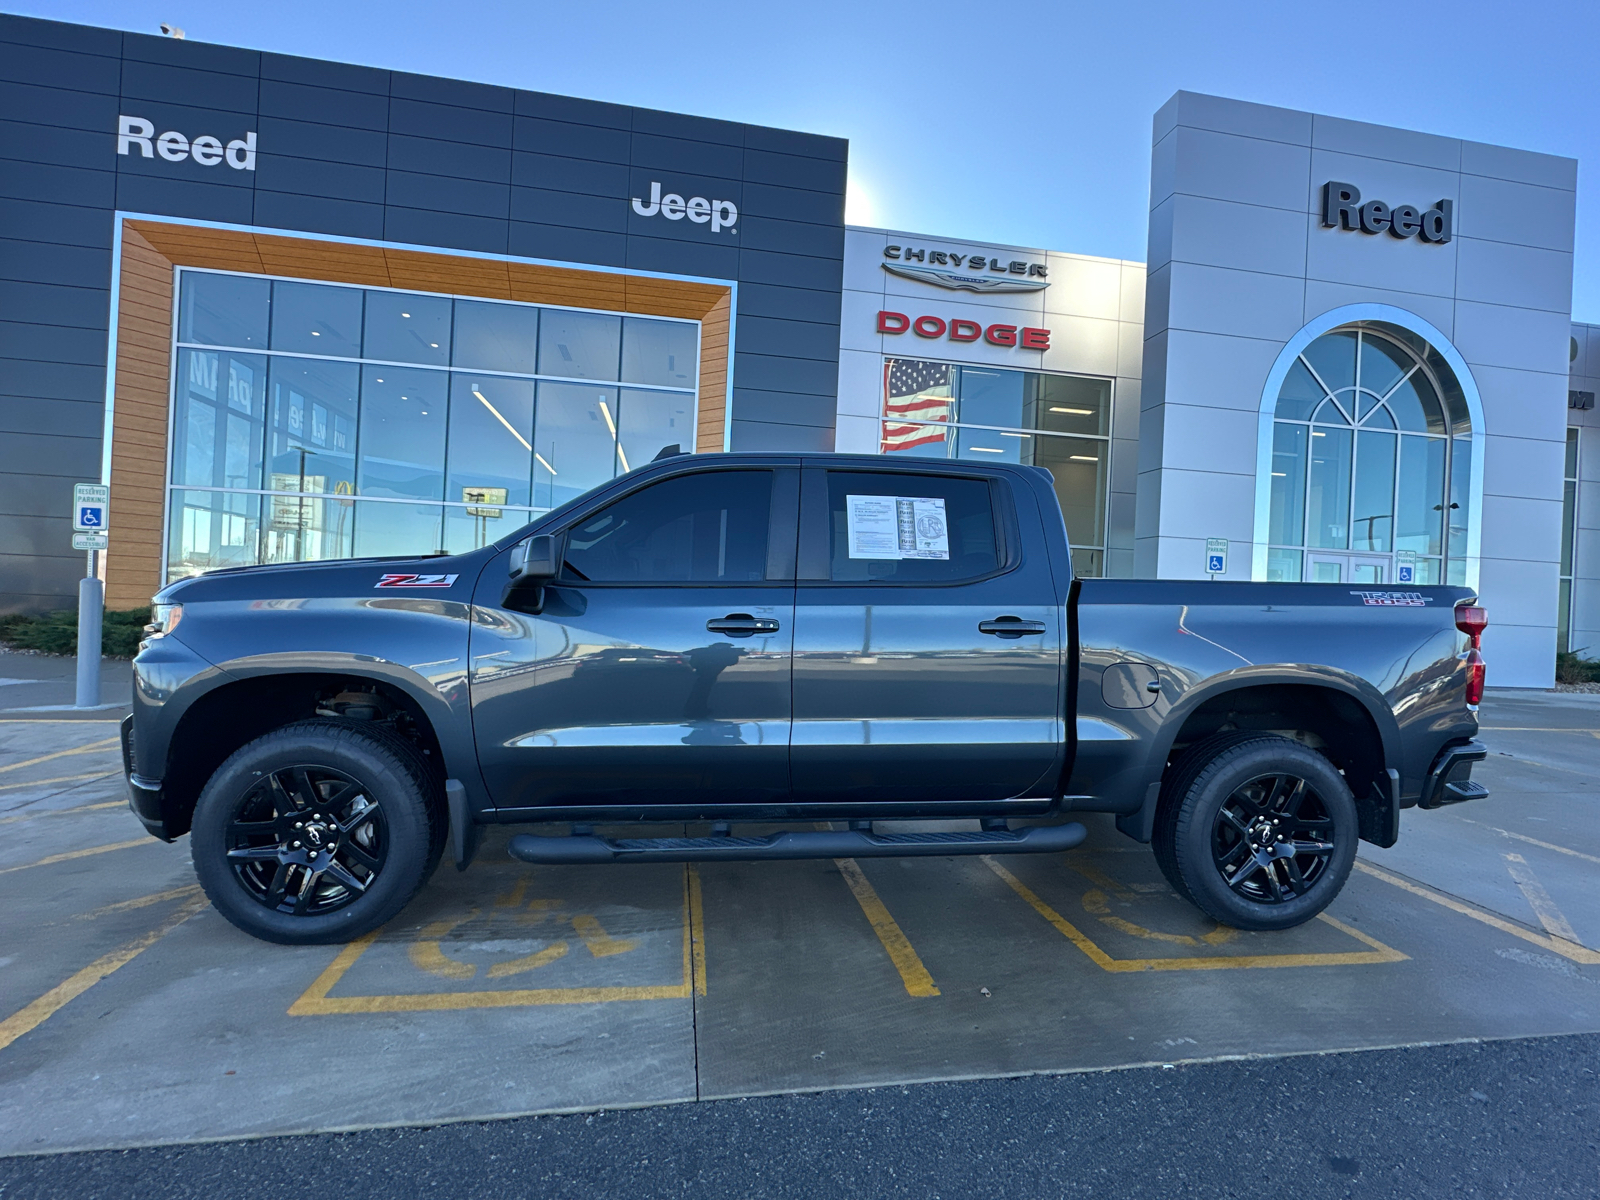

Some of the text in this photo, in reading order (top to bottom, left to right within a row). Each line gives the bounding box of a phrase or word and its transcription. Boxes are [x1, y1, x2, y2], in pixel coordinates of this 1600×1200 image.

[117, 114, 258, 171] Reed
[631, 181, 738, 233] Jeep
[1321, 180, 1454, 245] Reed
[883, 245, 1049, 277] CHRYSLER
[877, 310, 1052, 351] DODGE
[78, 488, 106, 496] RESERVED
[373, 573, 460, 588] Z71
[1350, 590, 1434, 602] TRAIL
[1363, 598, 1426, 607] BOSS
